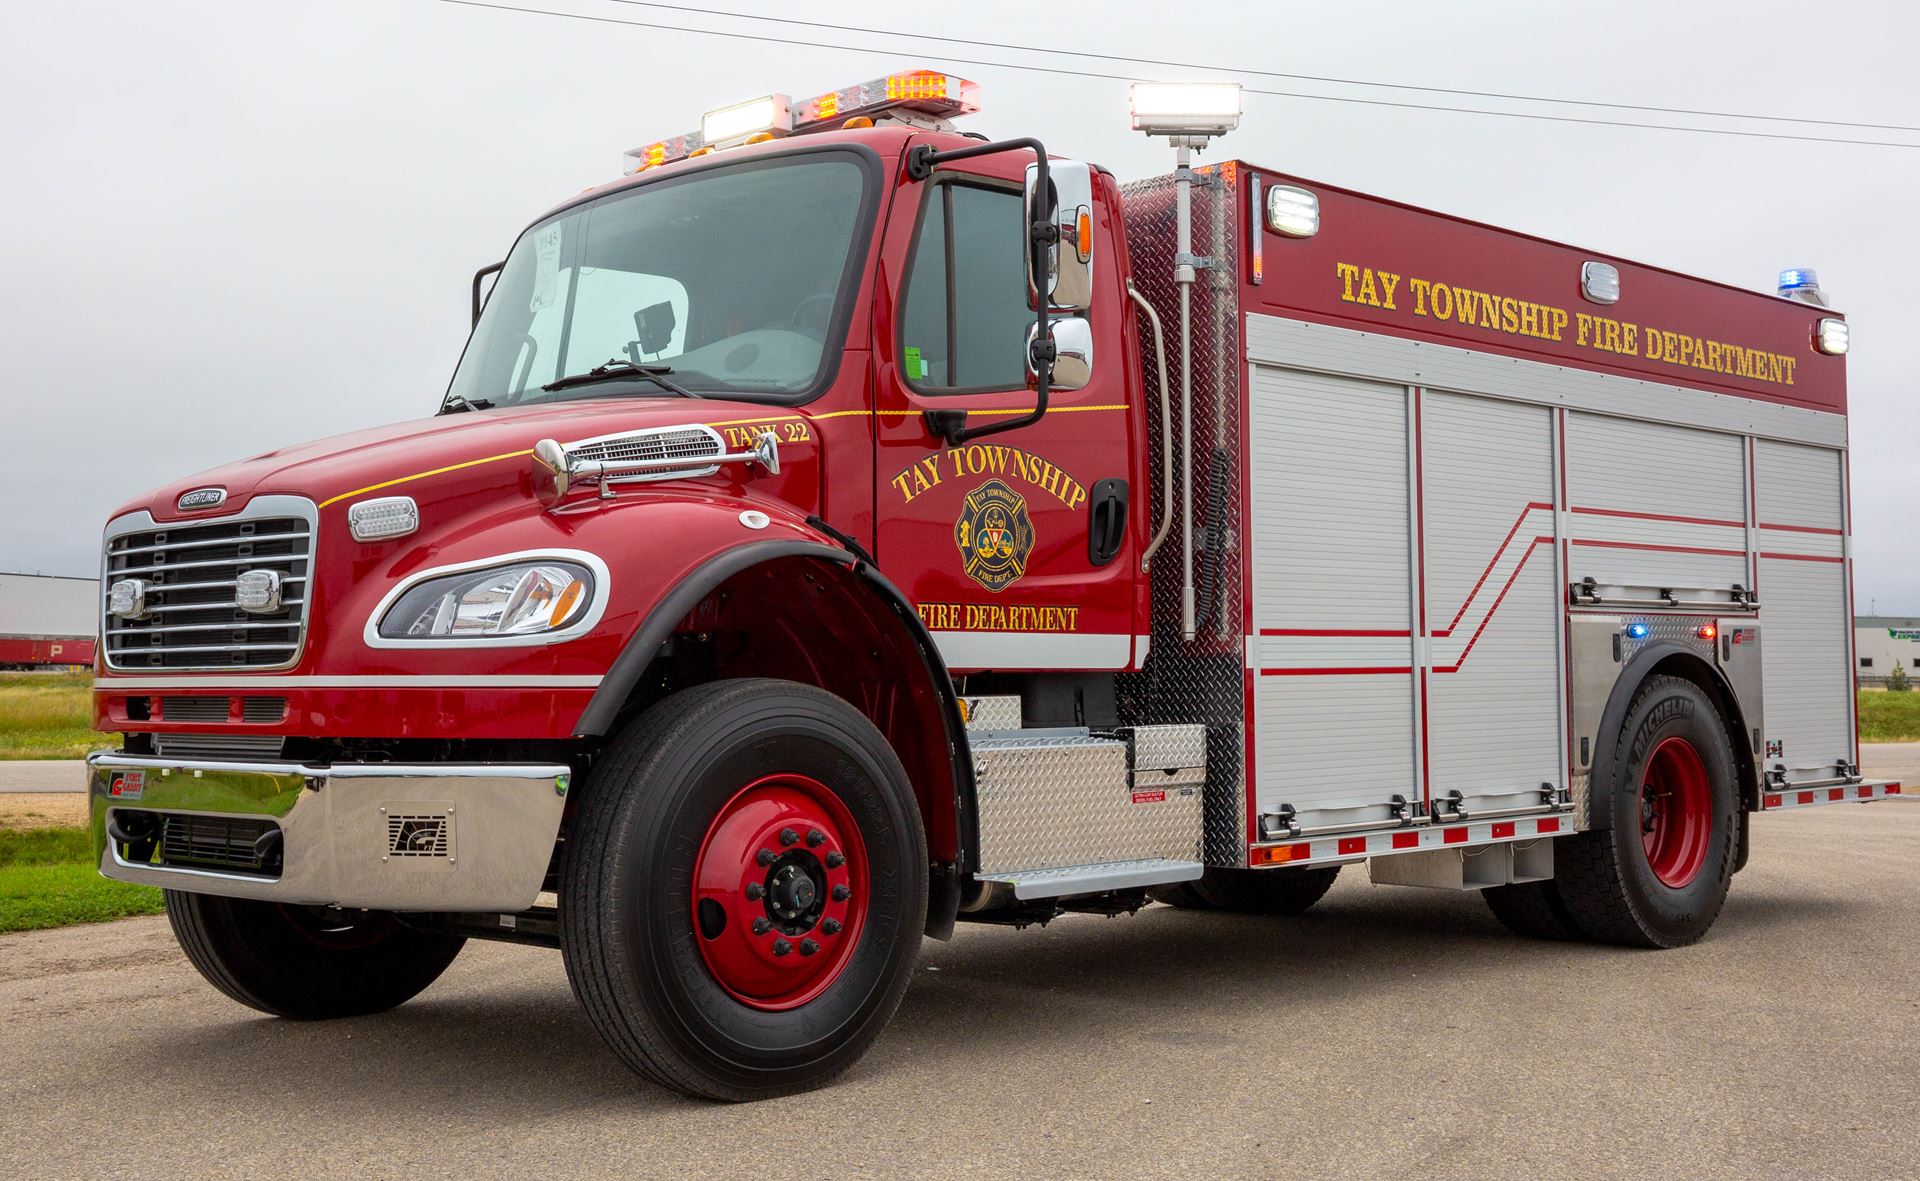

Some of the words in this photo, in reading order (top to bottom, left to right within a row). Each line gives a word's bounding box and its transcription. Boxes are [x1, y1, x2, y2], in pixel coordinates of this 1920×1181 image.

[1337, 262, 1400, 311] TAY
[1410, 278, 1568, 342] TOWNSHIP
[1575, 313, 1639, 355] FIRE
[1645, 327, 1797, 385] DEPARTMENT
[784, 422, 811, 442] 22
[892, 453, 943, 504] TAY
[948, 444, 1088, 511] TOWNSHIP
[975, 491, 986, 503] TAY
[986, 488, 1016, 504] TOWNSHIP
[979, 570, 993, 582] FIRE
[917, 603, 961, 629] FIRE
[965, 604, 1079, 631] DEPARTMENT
[1634, 697, 1695, 760] MICHELIN
